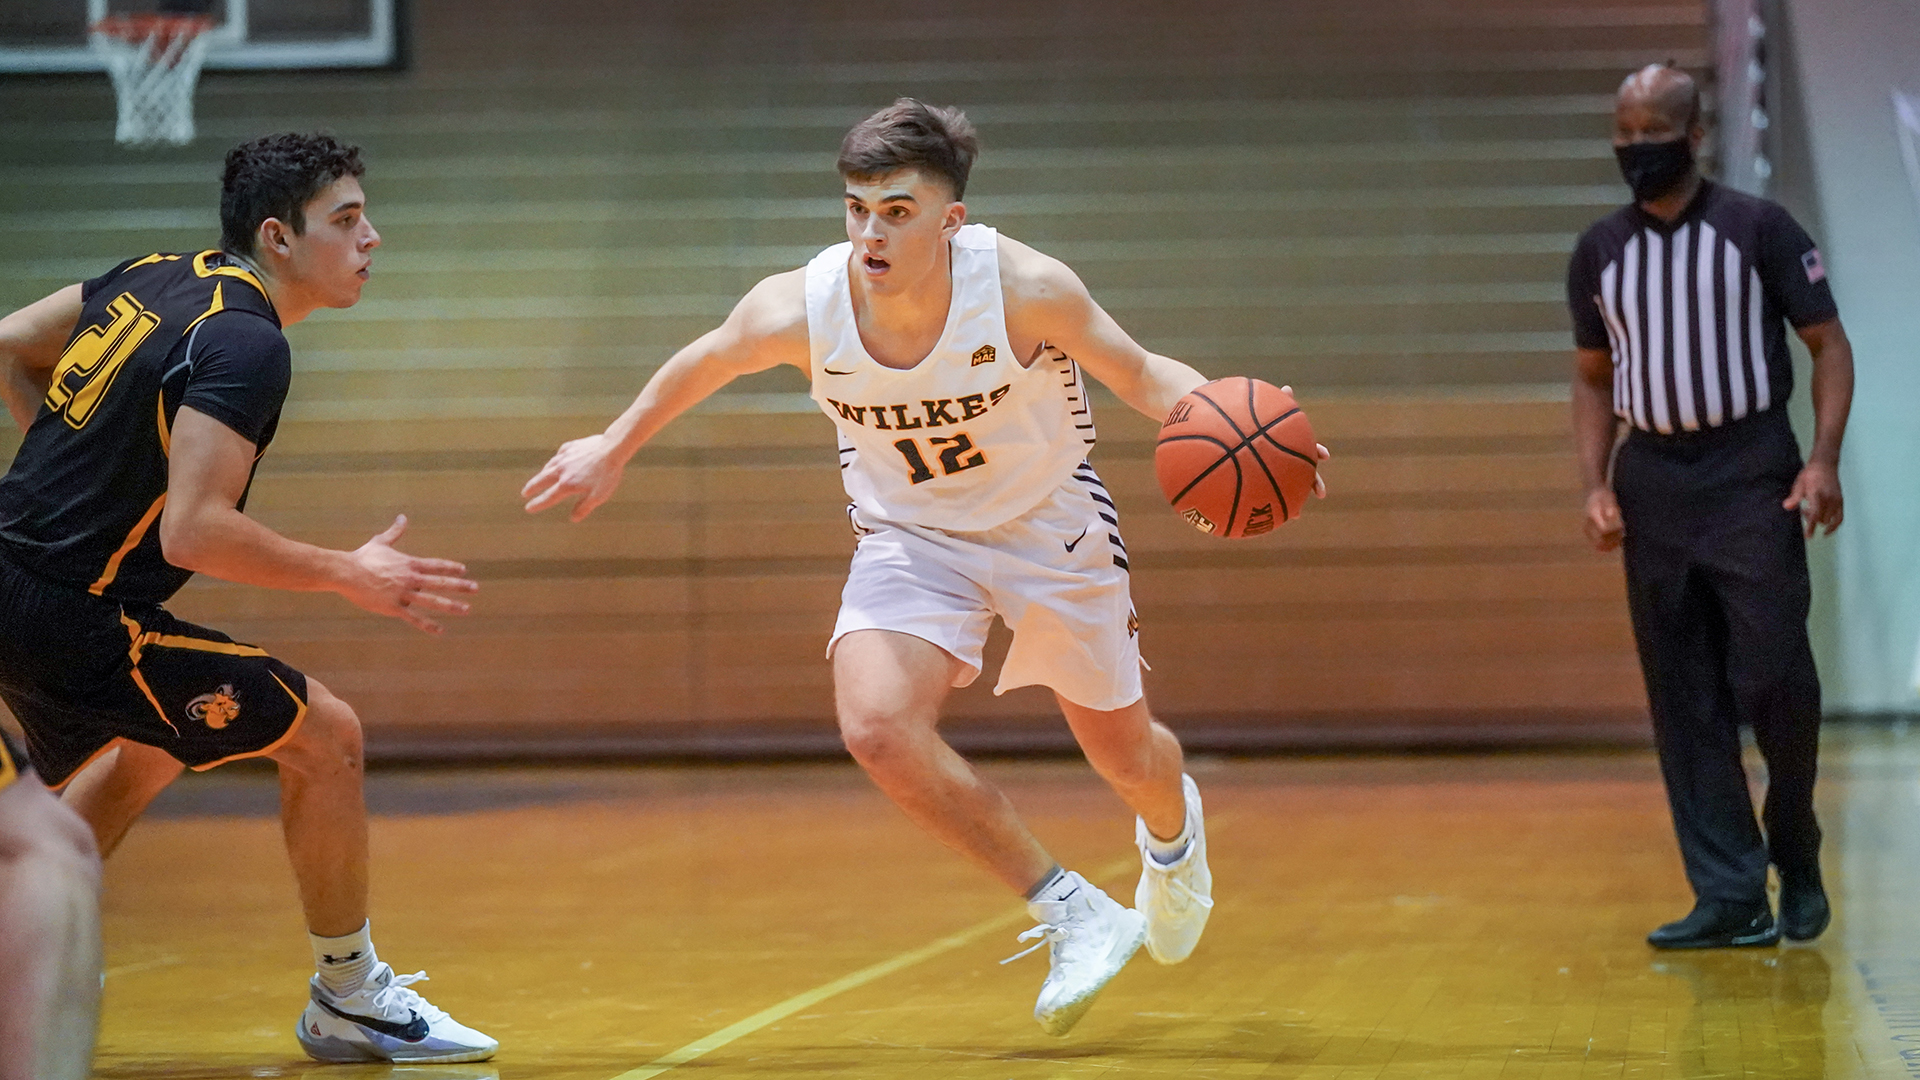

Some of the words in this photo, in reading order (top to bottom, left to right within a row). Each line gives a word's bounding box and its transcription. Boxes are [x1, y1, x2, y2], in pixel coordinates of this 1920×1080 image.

[45, 291, 162, 430] 21
[973, 353, 995, 365] MAC
[892, 432, 988, 485] 12
